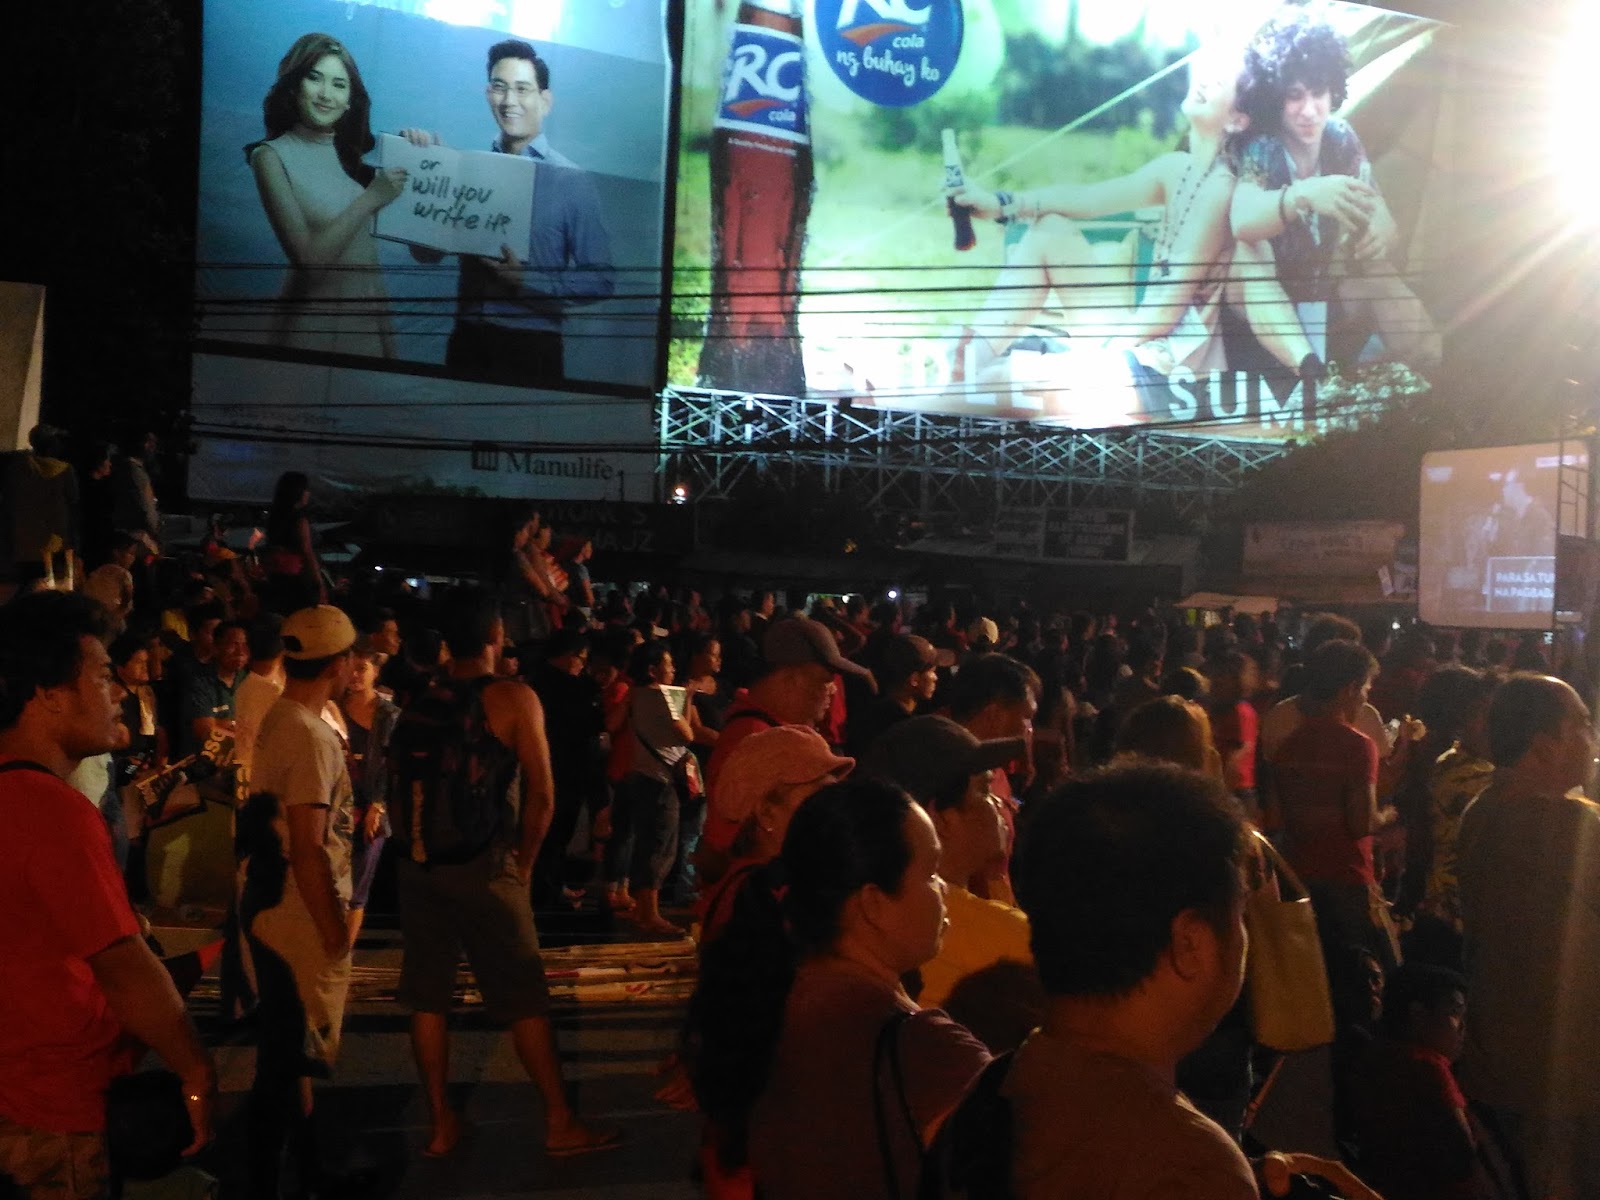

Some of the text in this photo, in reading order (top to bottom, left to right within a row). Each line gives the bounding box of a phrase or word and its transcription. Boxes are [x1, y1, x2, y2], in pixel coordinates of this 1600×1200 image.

[892, 33, 926, 49] cola
[724, 43, 801, 102] RC
[862, 45, 916, 87] buhay
[920, 56, 941, 82] ko
[768, 108, 797, 123] cola
[419, 159, 441, 171] or
[412, 175, 494, 208] will you
[413, 201, 480, 230] write
[1168, 365, 1328, 434] SUM
[505, 450, 613, 480] Manulife
